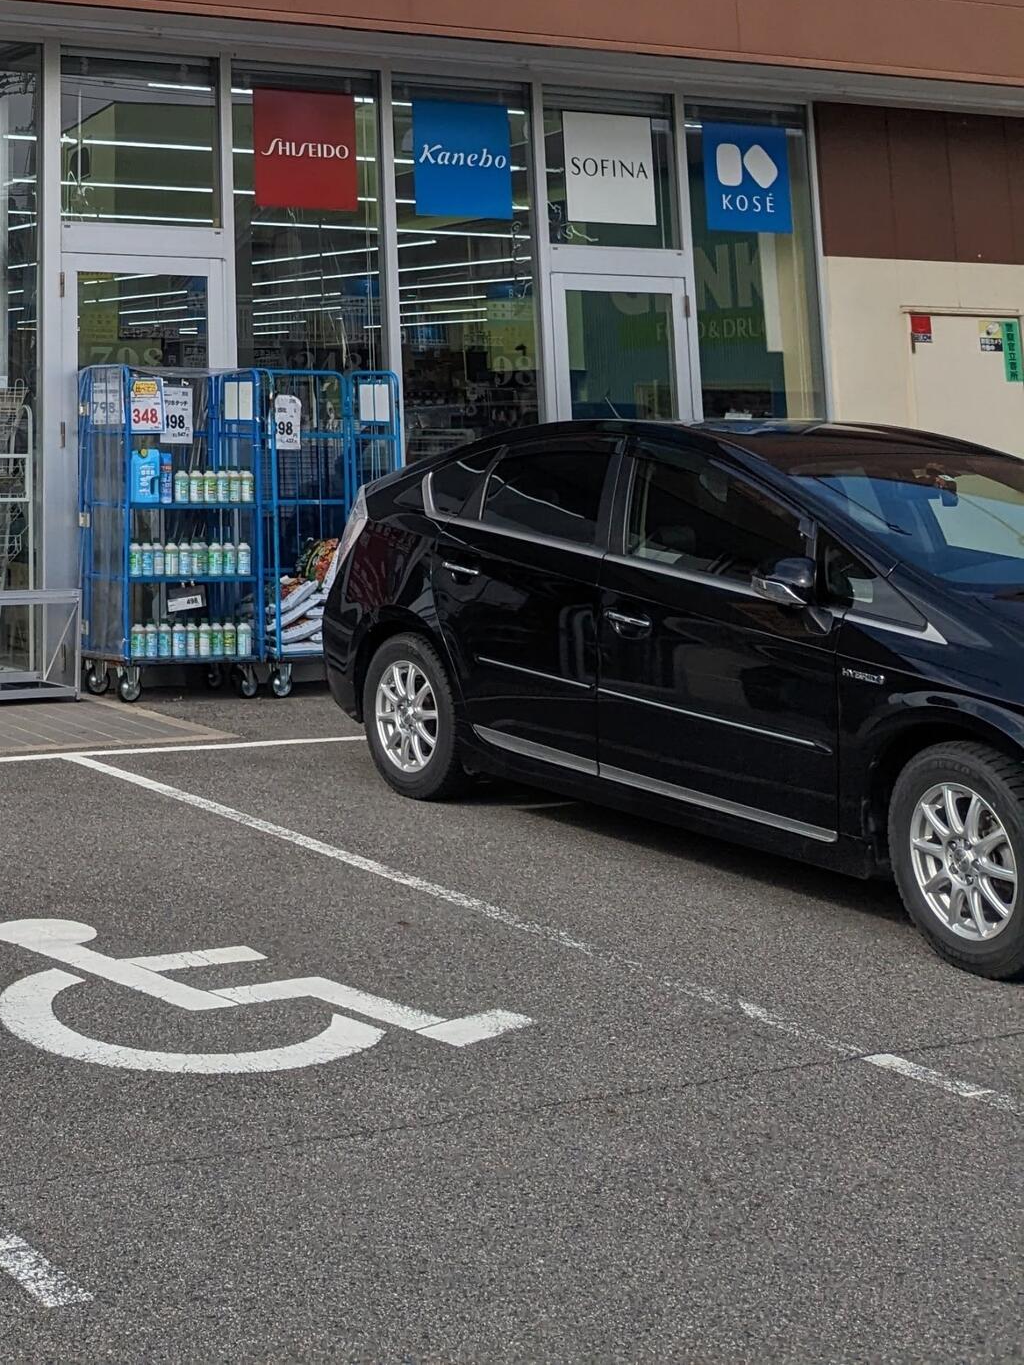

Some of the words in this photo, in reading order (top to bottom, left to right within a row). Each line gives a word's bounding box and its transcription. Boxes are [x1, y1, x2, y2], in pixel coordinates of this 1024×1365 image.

[261, 138, 349, 159] SHISEIDO
[419, 144, 506, 169] Kanebo
[571, 157, 648, 179] SOFINA
[722, 193, 775, 213] KOSÉ
[132, 408, 158, 424] 348
[276, 421, 293, 436] 98
